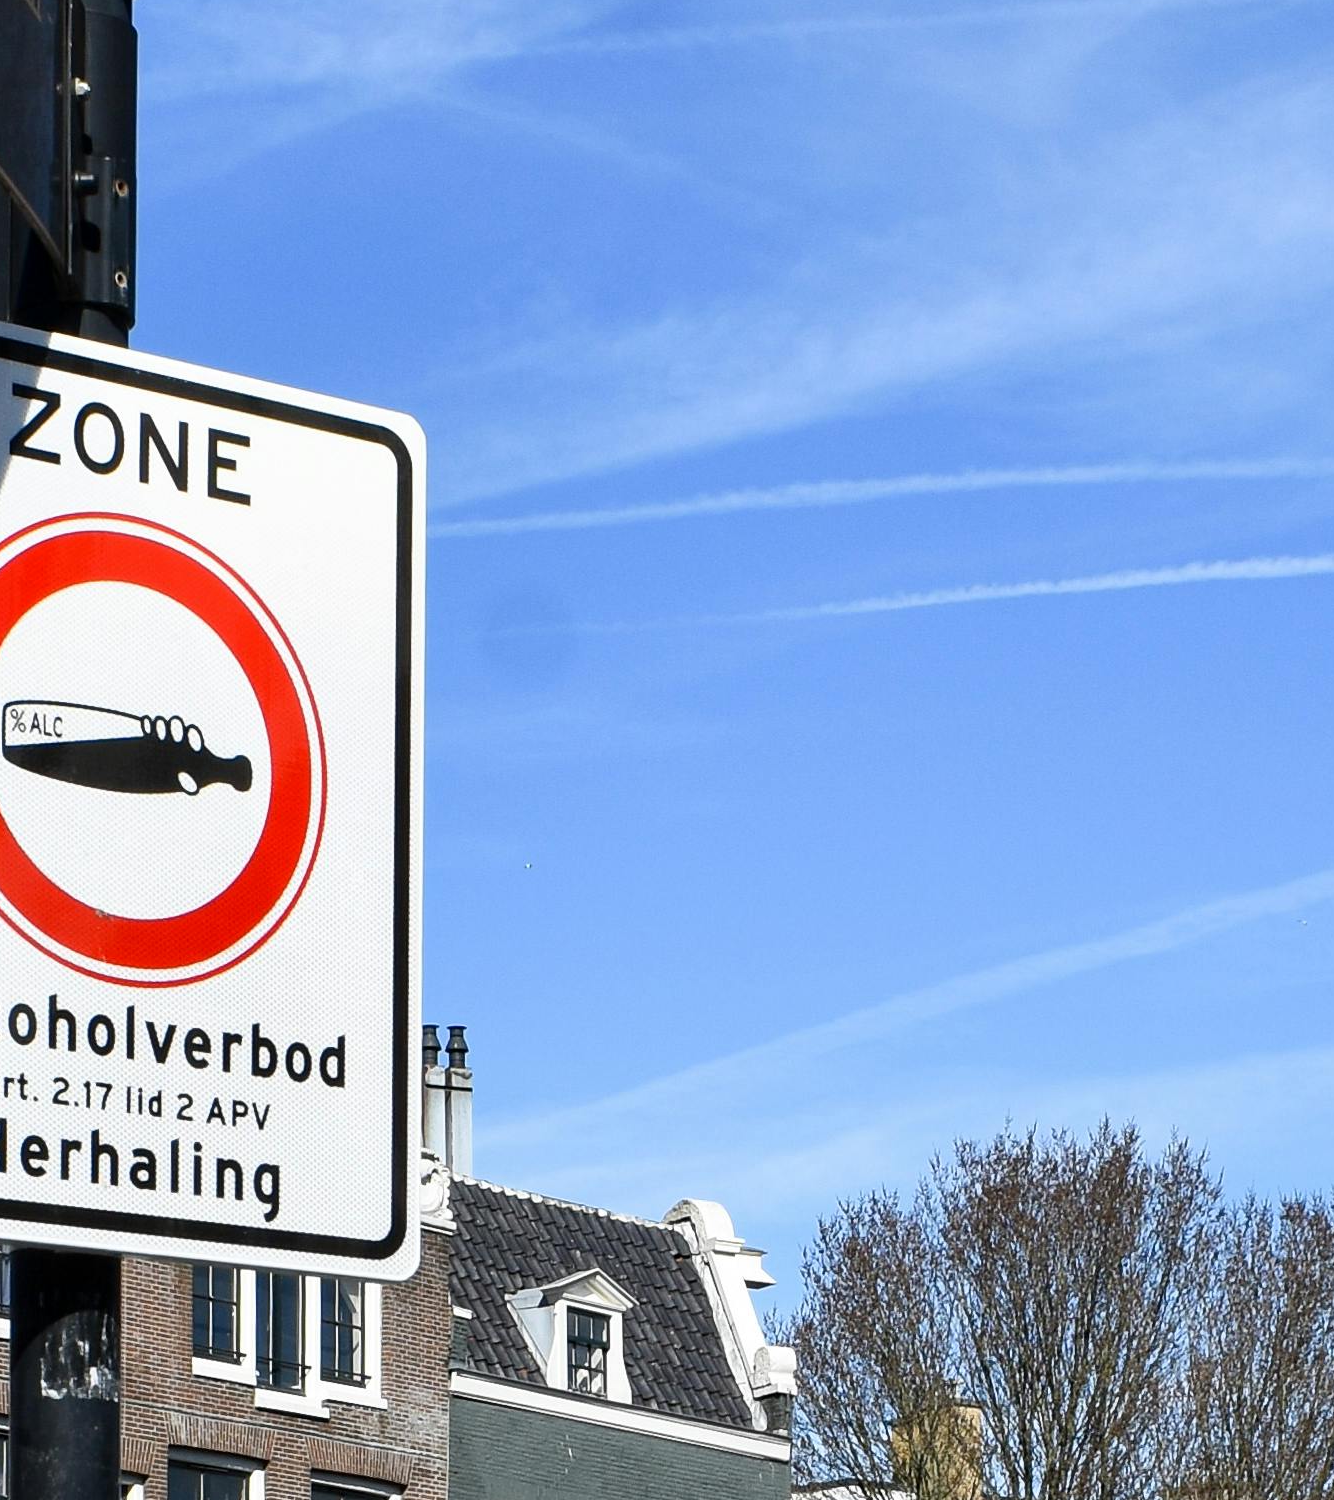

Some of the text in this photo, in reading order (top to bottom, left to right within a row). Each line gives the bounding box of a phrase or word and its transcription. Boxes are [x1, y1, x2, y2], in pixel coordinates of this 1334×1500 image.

[9, 383, 252, 507] ZONE
[53, 1075, 114, 1110] 2.17
[125, 1085, 165, 1119] lid
[176, 1092, 194, 1122] 2
[206, 1097, 271, 1131] APV
